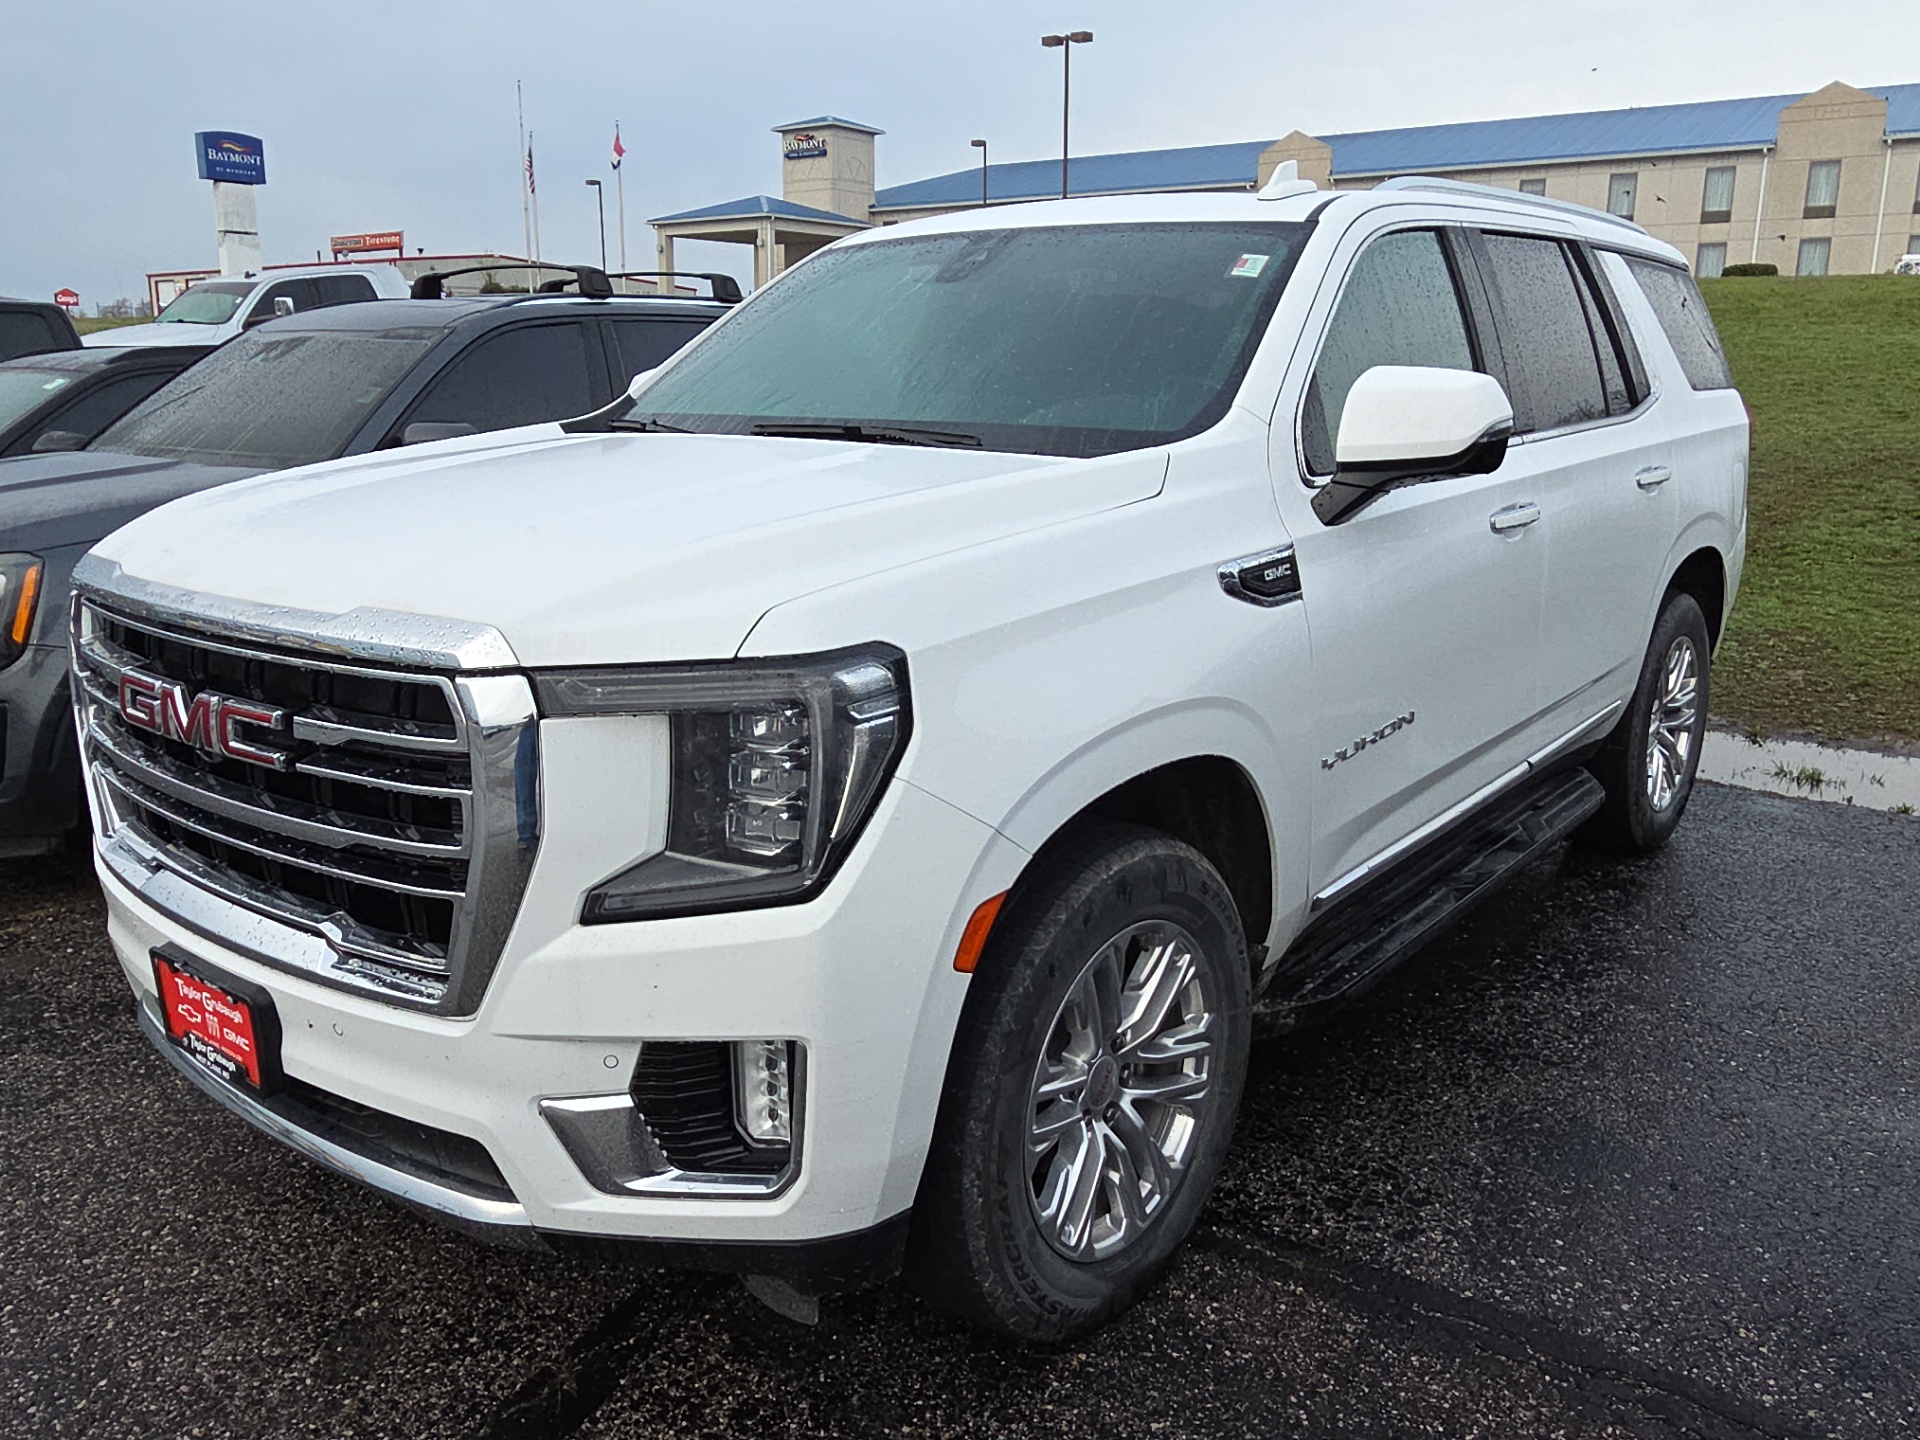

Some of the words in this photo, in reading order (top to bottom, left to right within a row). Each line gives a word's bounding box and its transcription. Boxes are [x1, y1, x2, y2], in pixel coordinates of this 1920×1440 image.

[783, 138, 826, 152] BAYMONT
[207, 147, 261, 166] BAYMONT
[1263, 563, 1291, 581] GMC
[119, 670, 288, 772] GMC
[1321, 709, 1415, 770] YUKON
[223, 1027, 250, 1052] GMC
